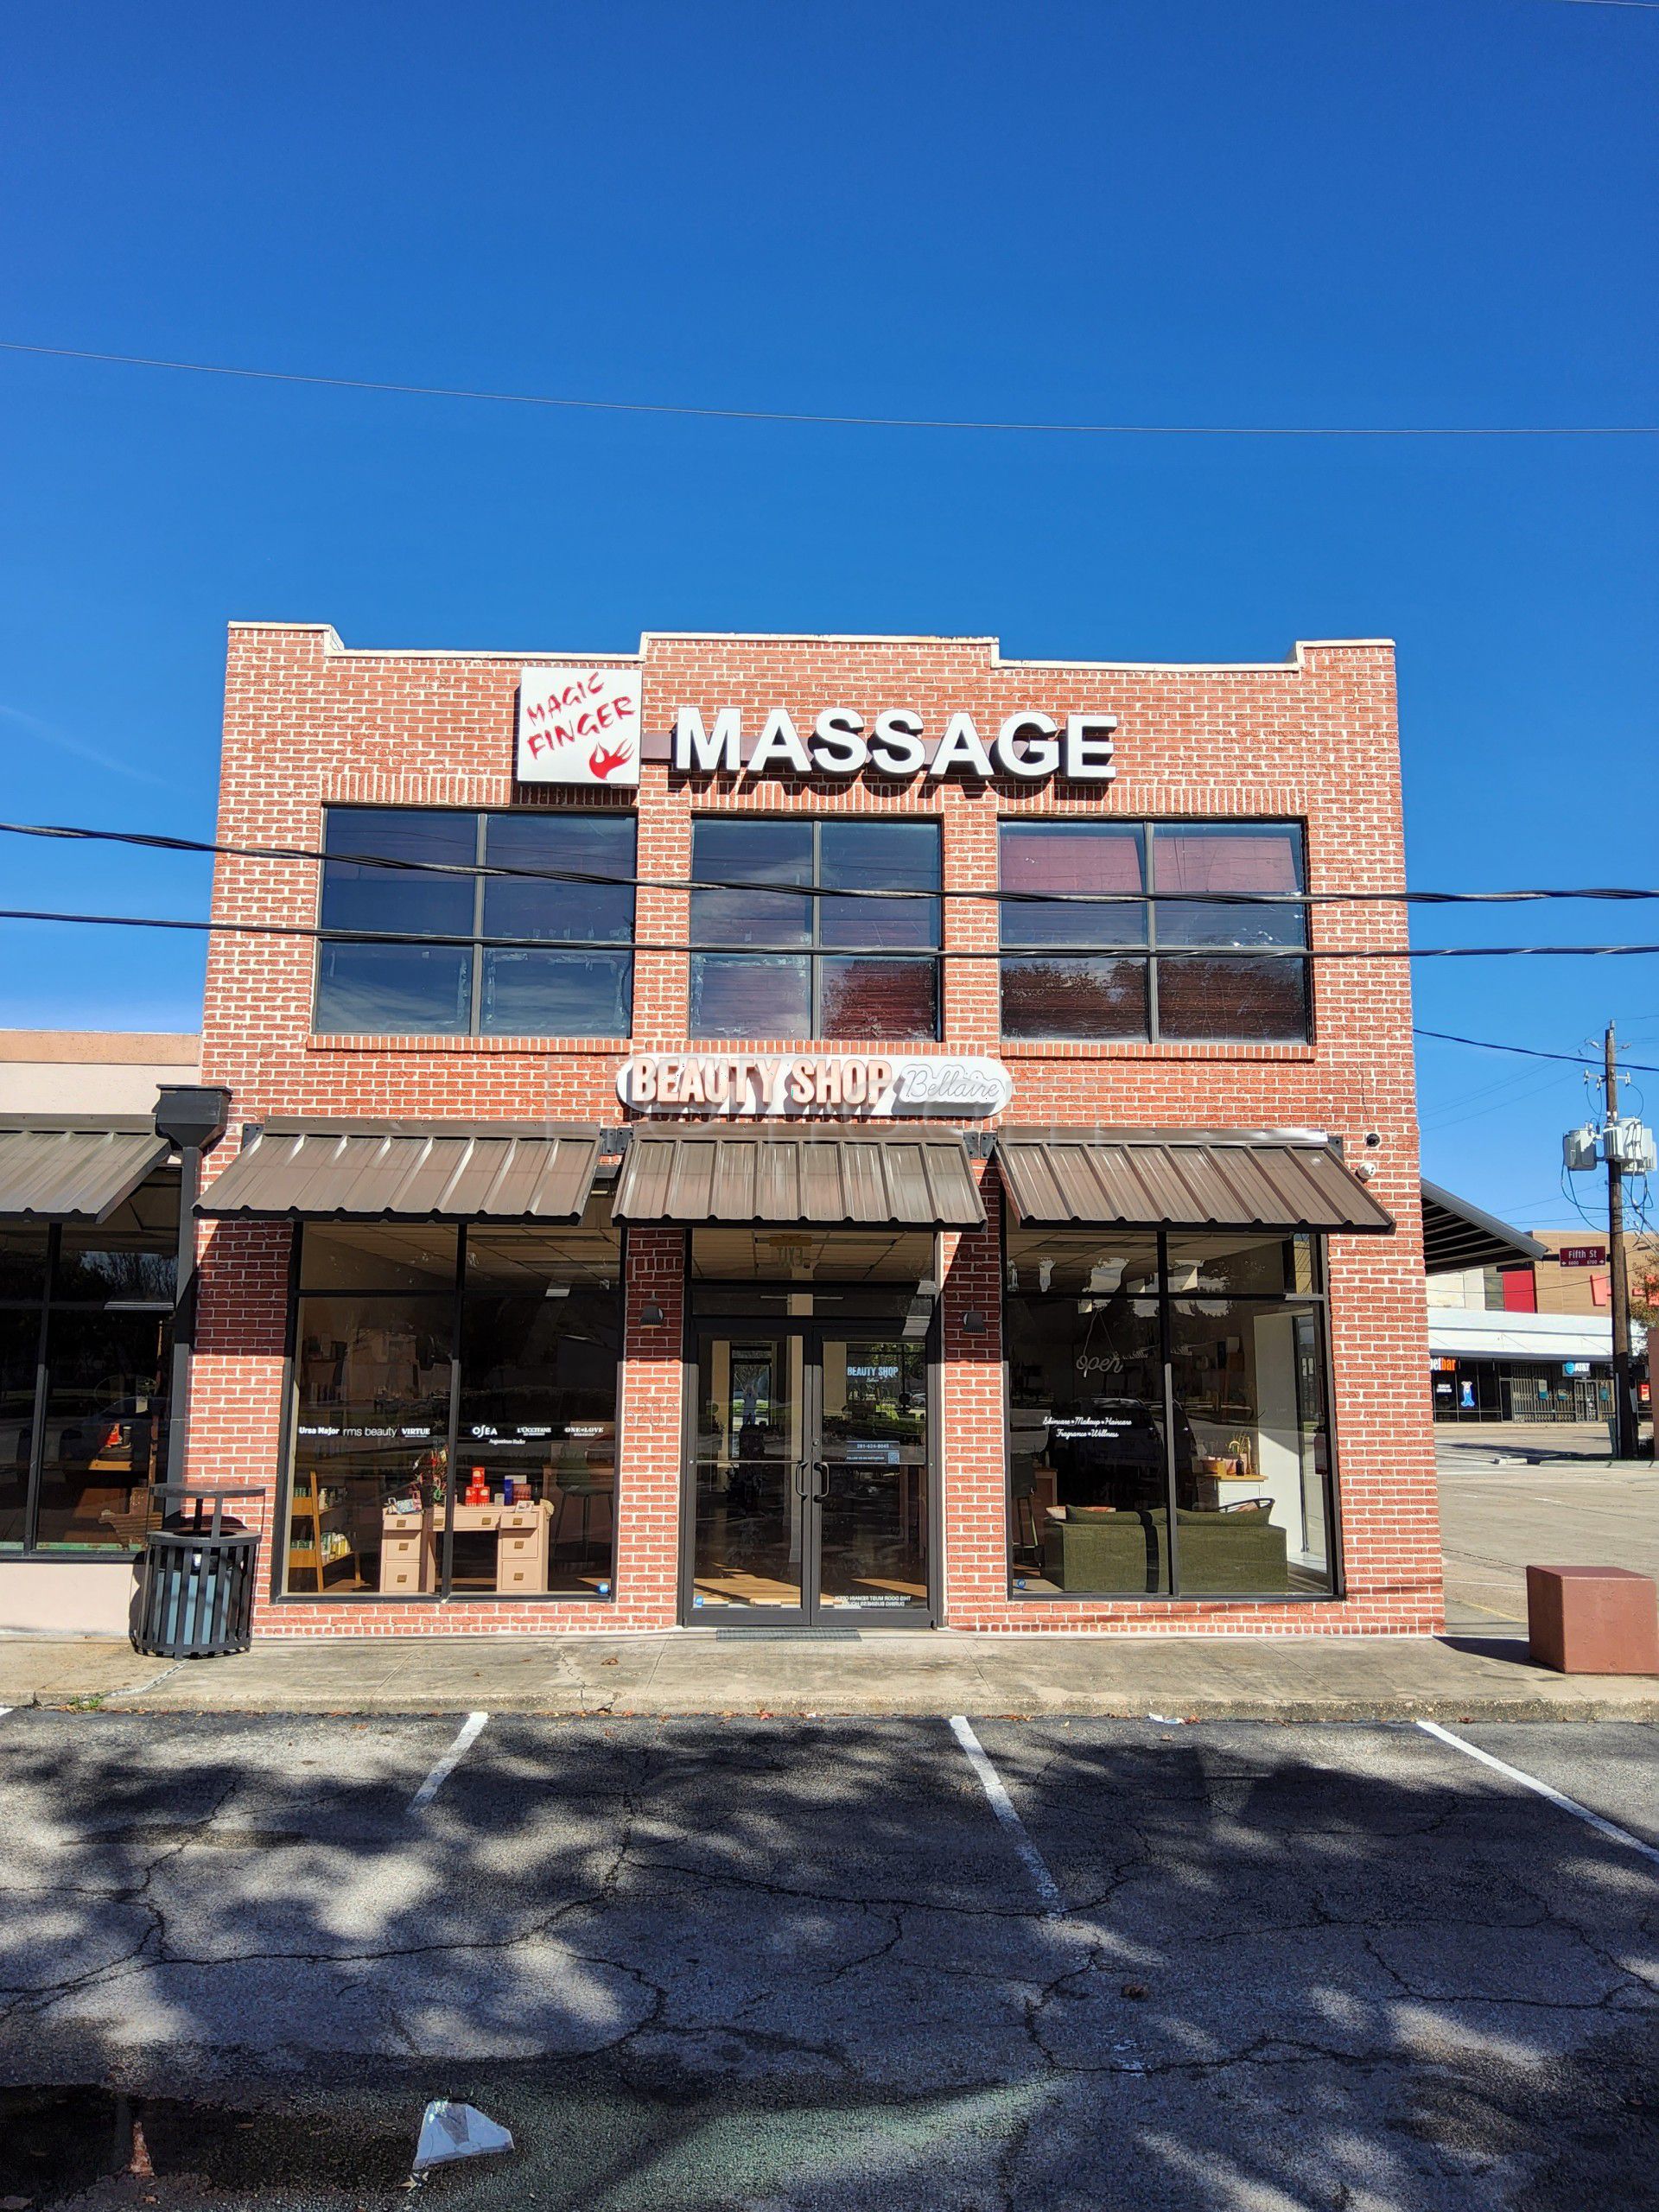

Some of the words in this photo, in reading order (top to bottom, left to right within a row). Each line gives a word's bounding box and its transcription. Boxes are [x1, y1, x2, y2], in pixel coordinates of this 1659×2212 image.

[526, 671, 604, 726] MAGIC
[526, 696, 636, 760] FINGER
[674, 706, 1119, 780] MASSAGE
[632, 1057, 781, 1103] BEAUTY
[791, 1057, 893, 1105] SHOP
[906, 1067, 1001, 1100] Bellaire
[1568, 1249, 1586, 1259] Fifth
[1589, 1249, 1598, 1258] St
[847, 1366, 876, 1376] BEAUTY
[878, 1366, 899, 1377] SHOP
[1076, 1355, 1123, 1378] open
[1574, 1363, 1590, 1372] AT&T
[1042, 1416, 1071, 1426] Skincare
[1074, 1416, 1101, 1427] Makeup
[1105, 1417, 1133, 1426] Haircare
[298, 1426, 317, 1435] Ursa
[317, 1426, 340, 1437] Major
[342, 1427, 363, 1437] rms
[364, 1426, 398, 1439] beauty
[1056, 1428, 1087, 1440] Fragrance
[1090, 1429, 1120, 1438] Wellness
